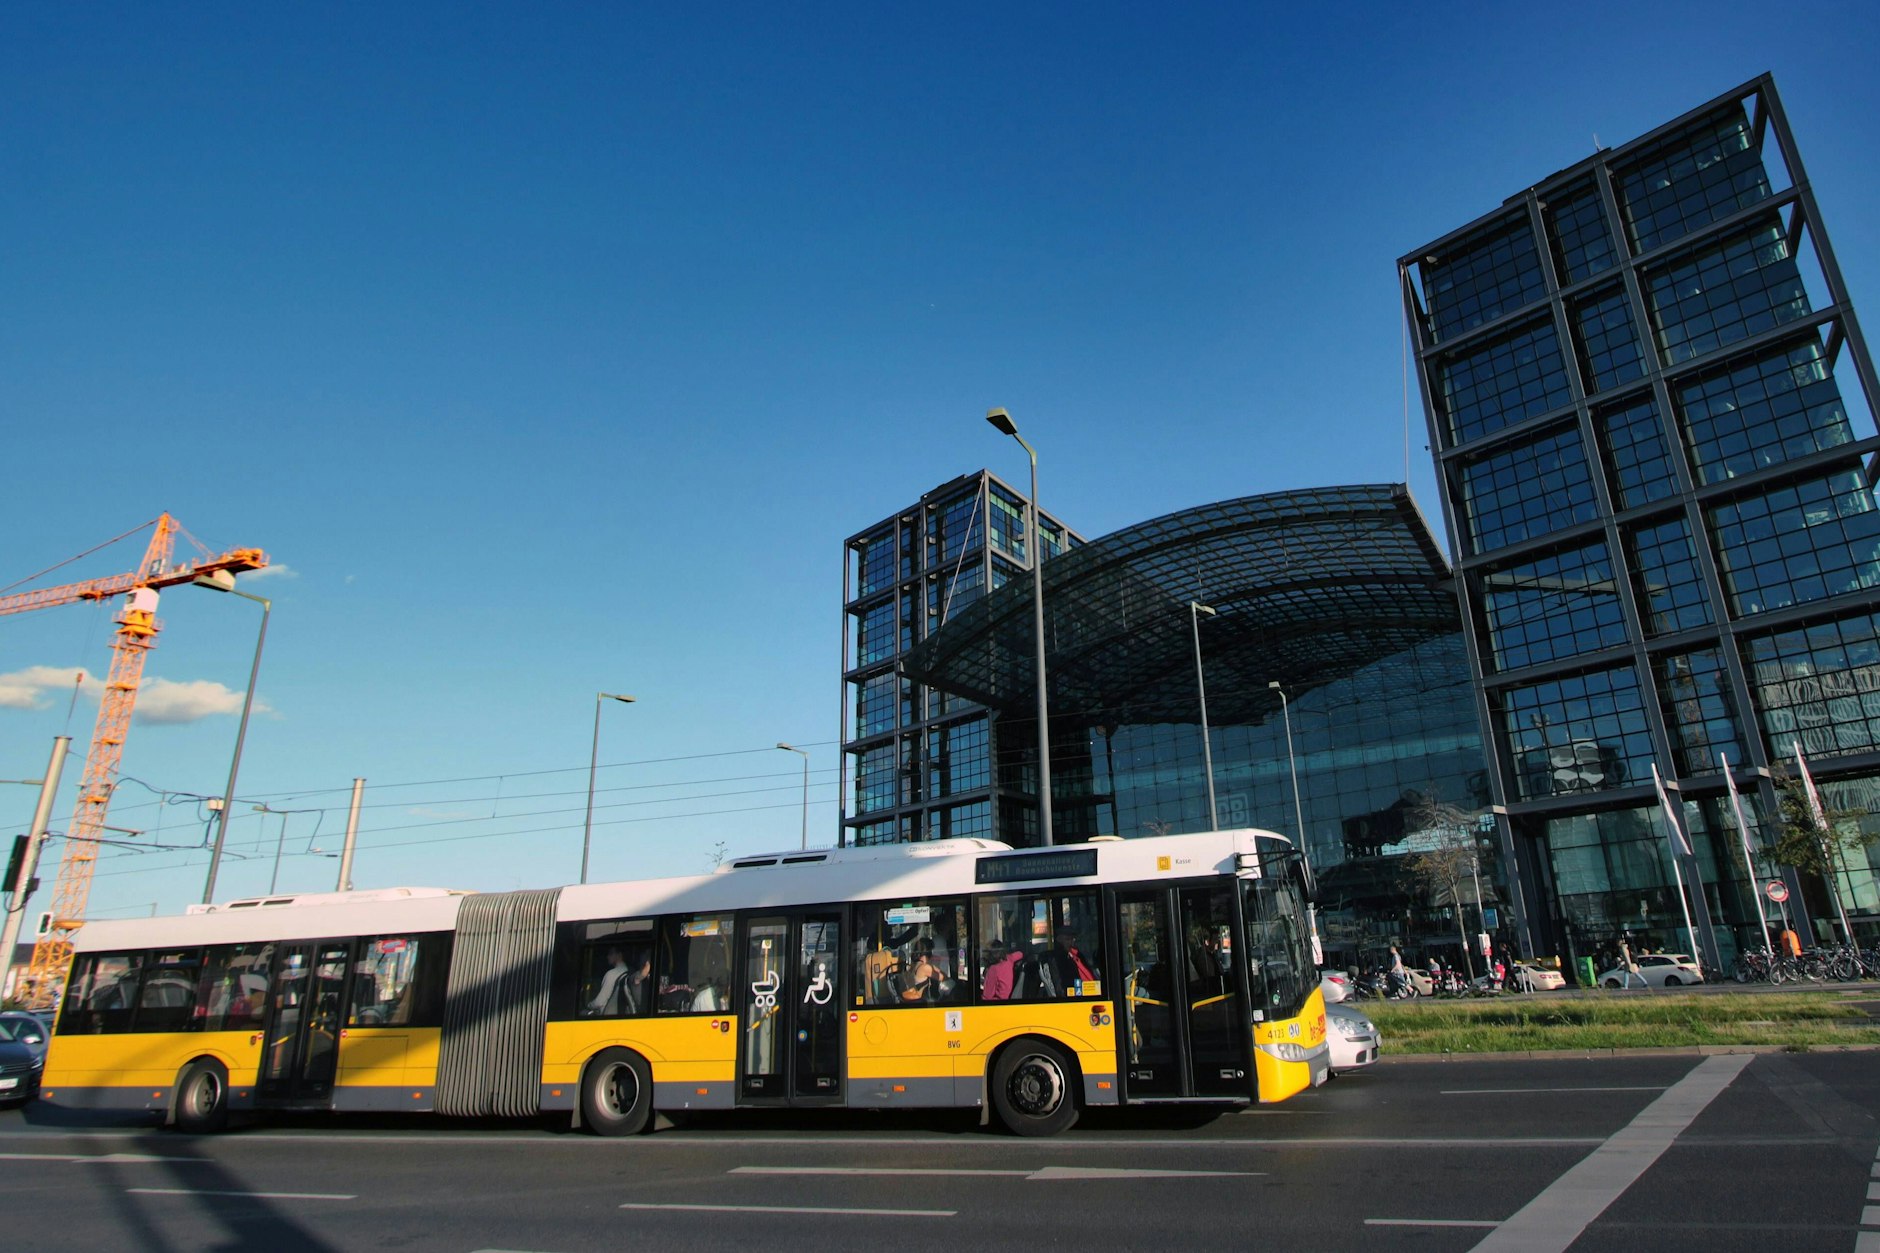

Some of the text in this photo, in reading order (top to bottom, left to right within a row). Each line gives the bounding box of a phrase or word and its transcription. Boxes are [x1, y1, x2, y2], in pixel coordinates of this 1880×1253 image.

[1217, 798, 1244, 826] DB
[987, 861, 1010, 878] M41
[1267, 1028, 1285, 1039] 4123
[947, 1040, 961, 1049] BVG
